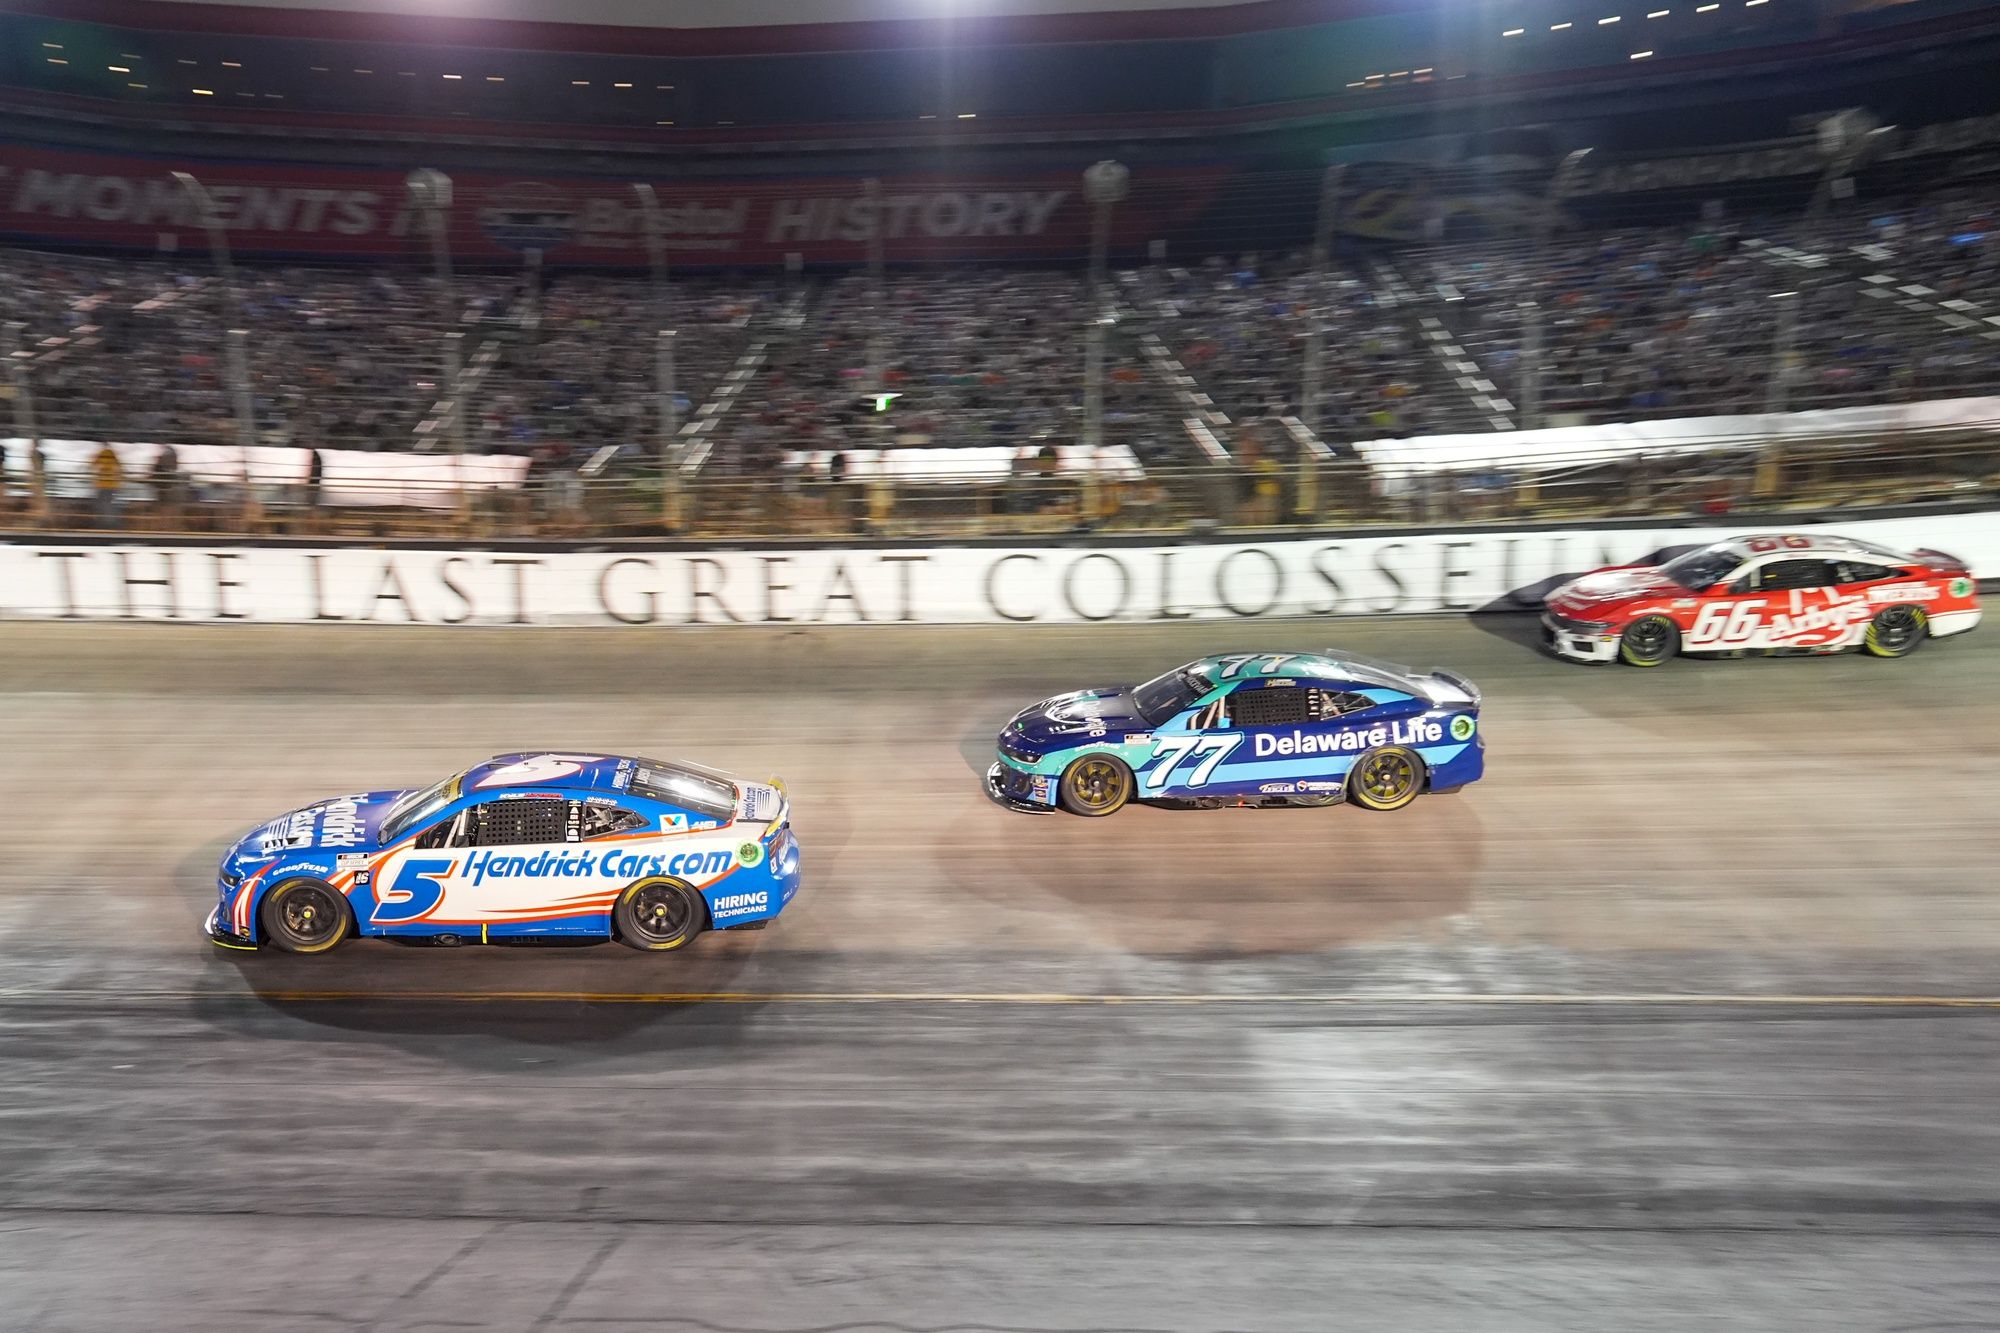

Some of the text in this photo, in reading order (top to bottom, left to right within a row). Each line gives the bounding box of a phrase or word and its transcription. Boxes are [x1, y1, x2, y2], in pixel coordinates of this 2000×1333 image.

[12, 168, 386, 237] MOMENTS
[765, 190, 1070, 244] HISTORY
[35, 551, 250, 619] THE
[304, 554, 547, 624] LAST
[596, 555, 938, 625] GREAT
[1689, 599, 1768, 644] 66
[1218, 653, 1300, 679] 77
[1255, 717, 1443, 757] Delaware Life
[1145, 733, 1243, 789] 77
[272, 862, 328, 876] GOODYEAR
[355, 871, 369, 886] 16
[370, 857, 457, 924] 5
[713, 891, 769, 911] HIRING
[713, 904, 768, 919] TECHNICIANS
